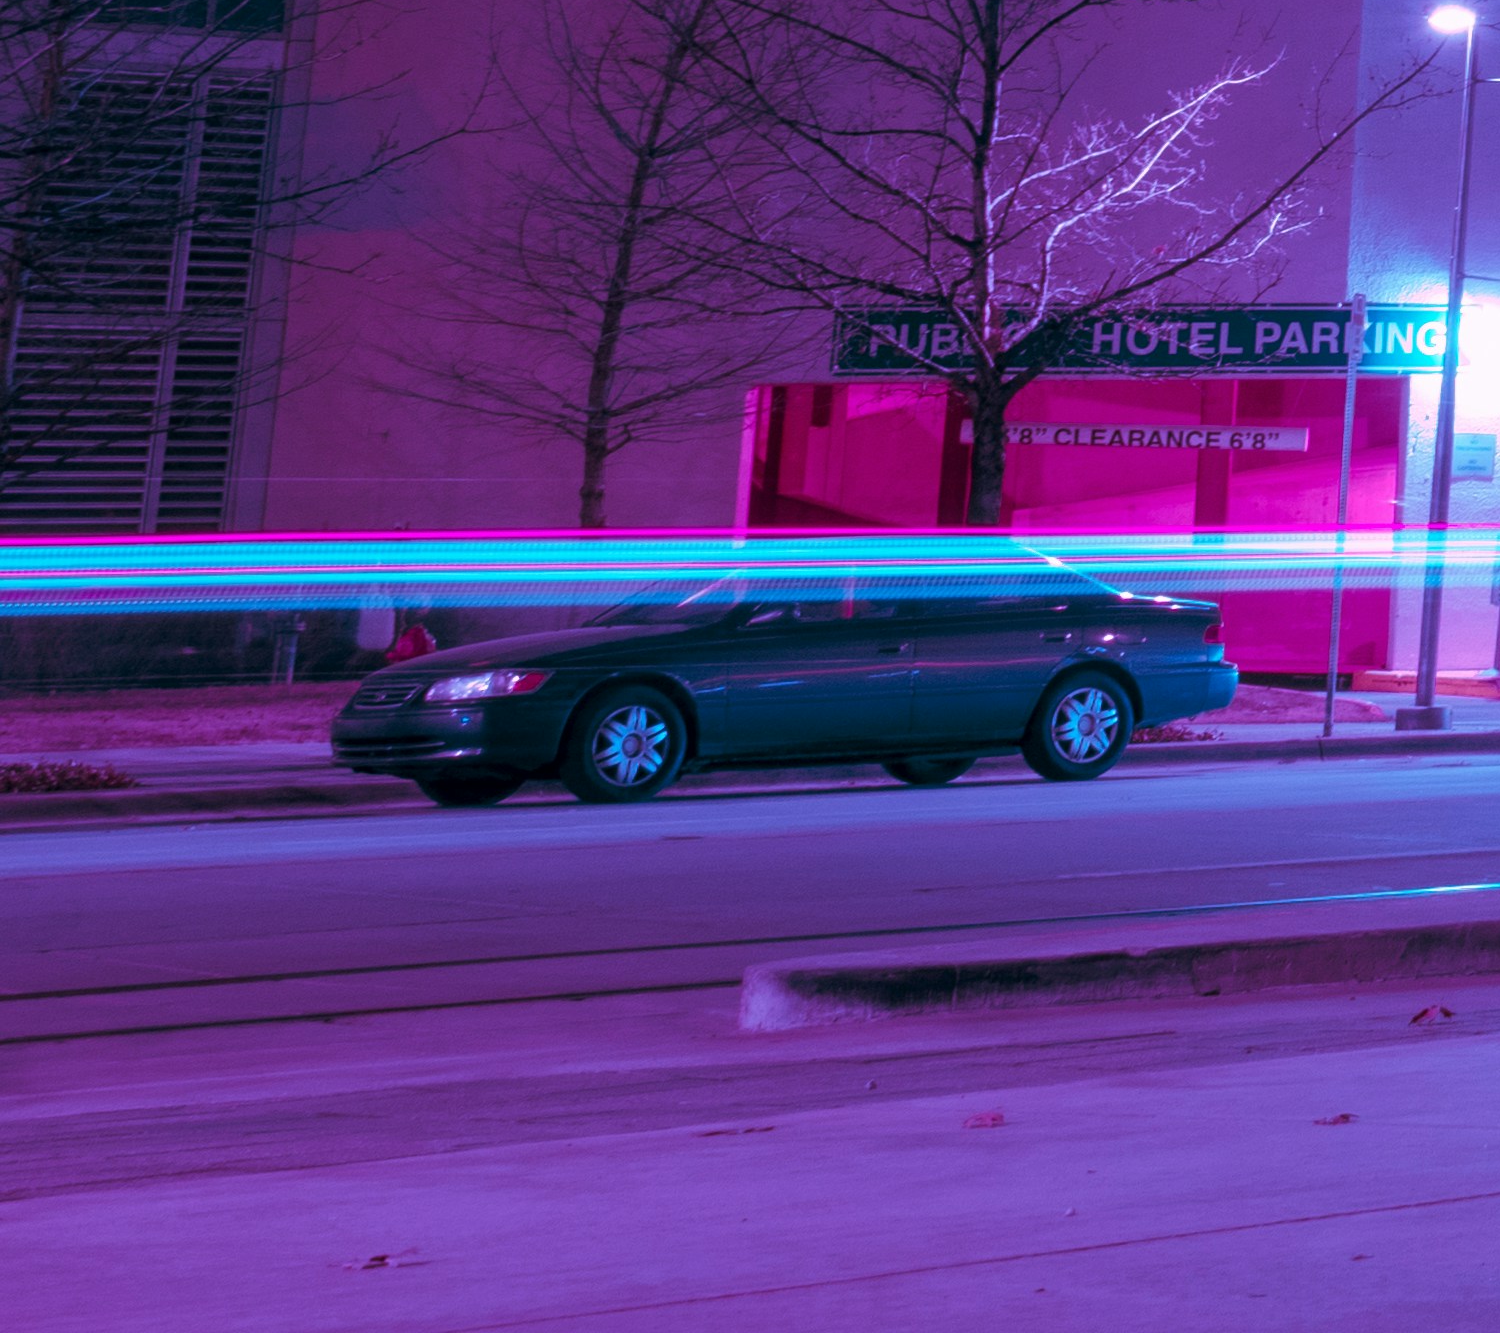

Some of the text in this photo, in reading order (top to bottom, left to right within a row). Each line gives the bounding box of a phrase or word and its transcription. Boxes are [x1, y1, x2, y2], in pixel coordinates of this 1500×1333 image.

[1091, 321, 1244, 356] HOTEL
[1253, 320, 1449, 357] PARKING
[1054, 427, 1222, 450] CLEARANCE
